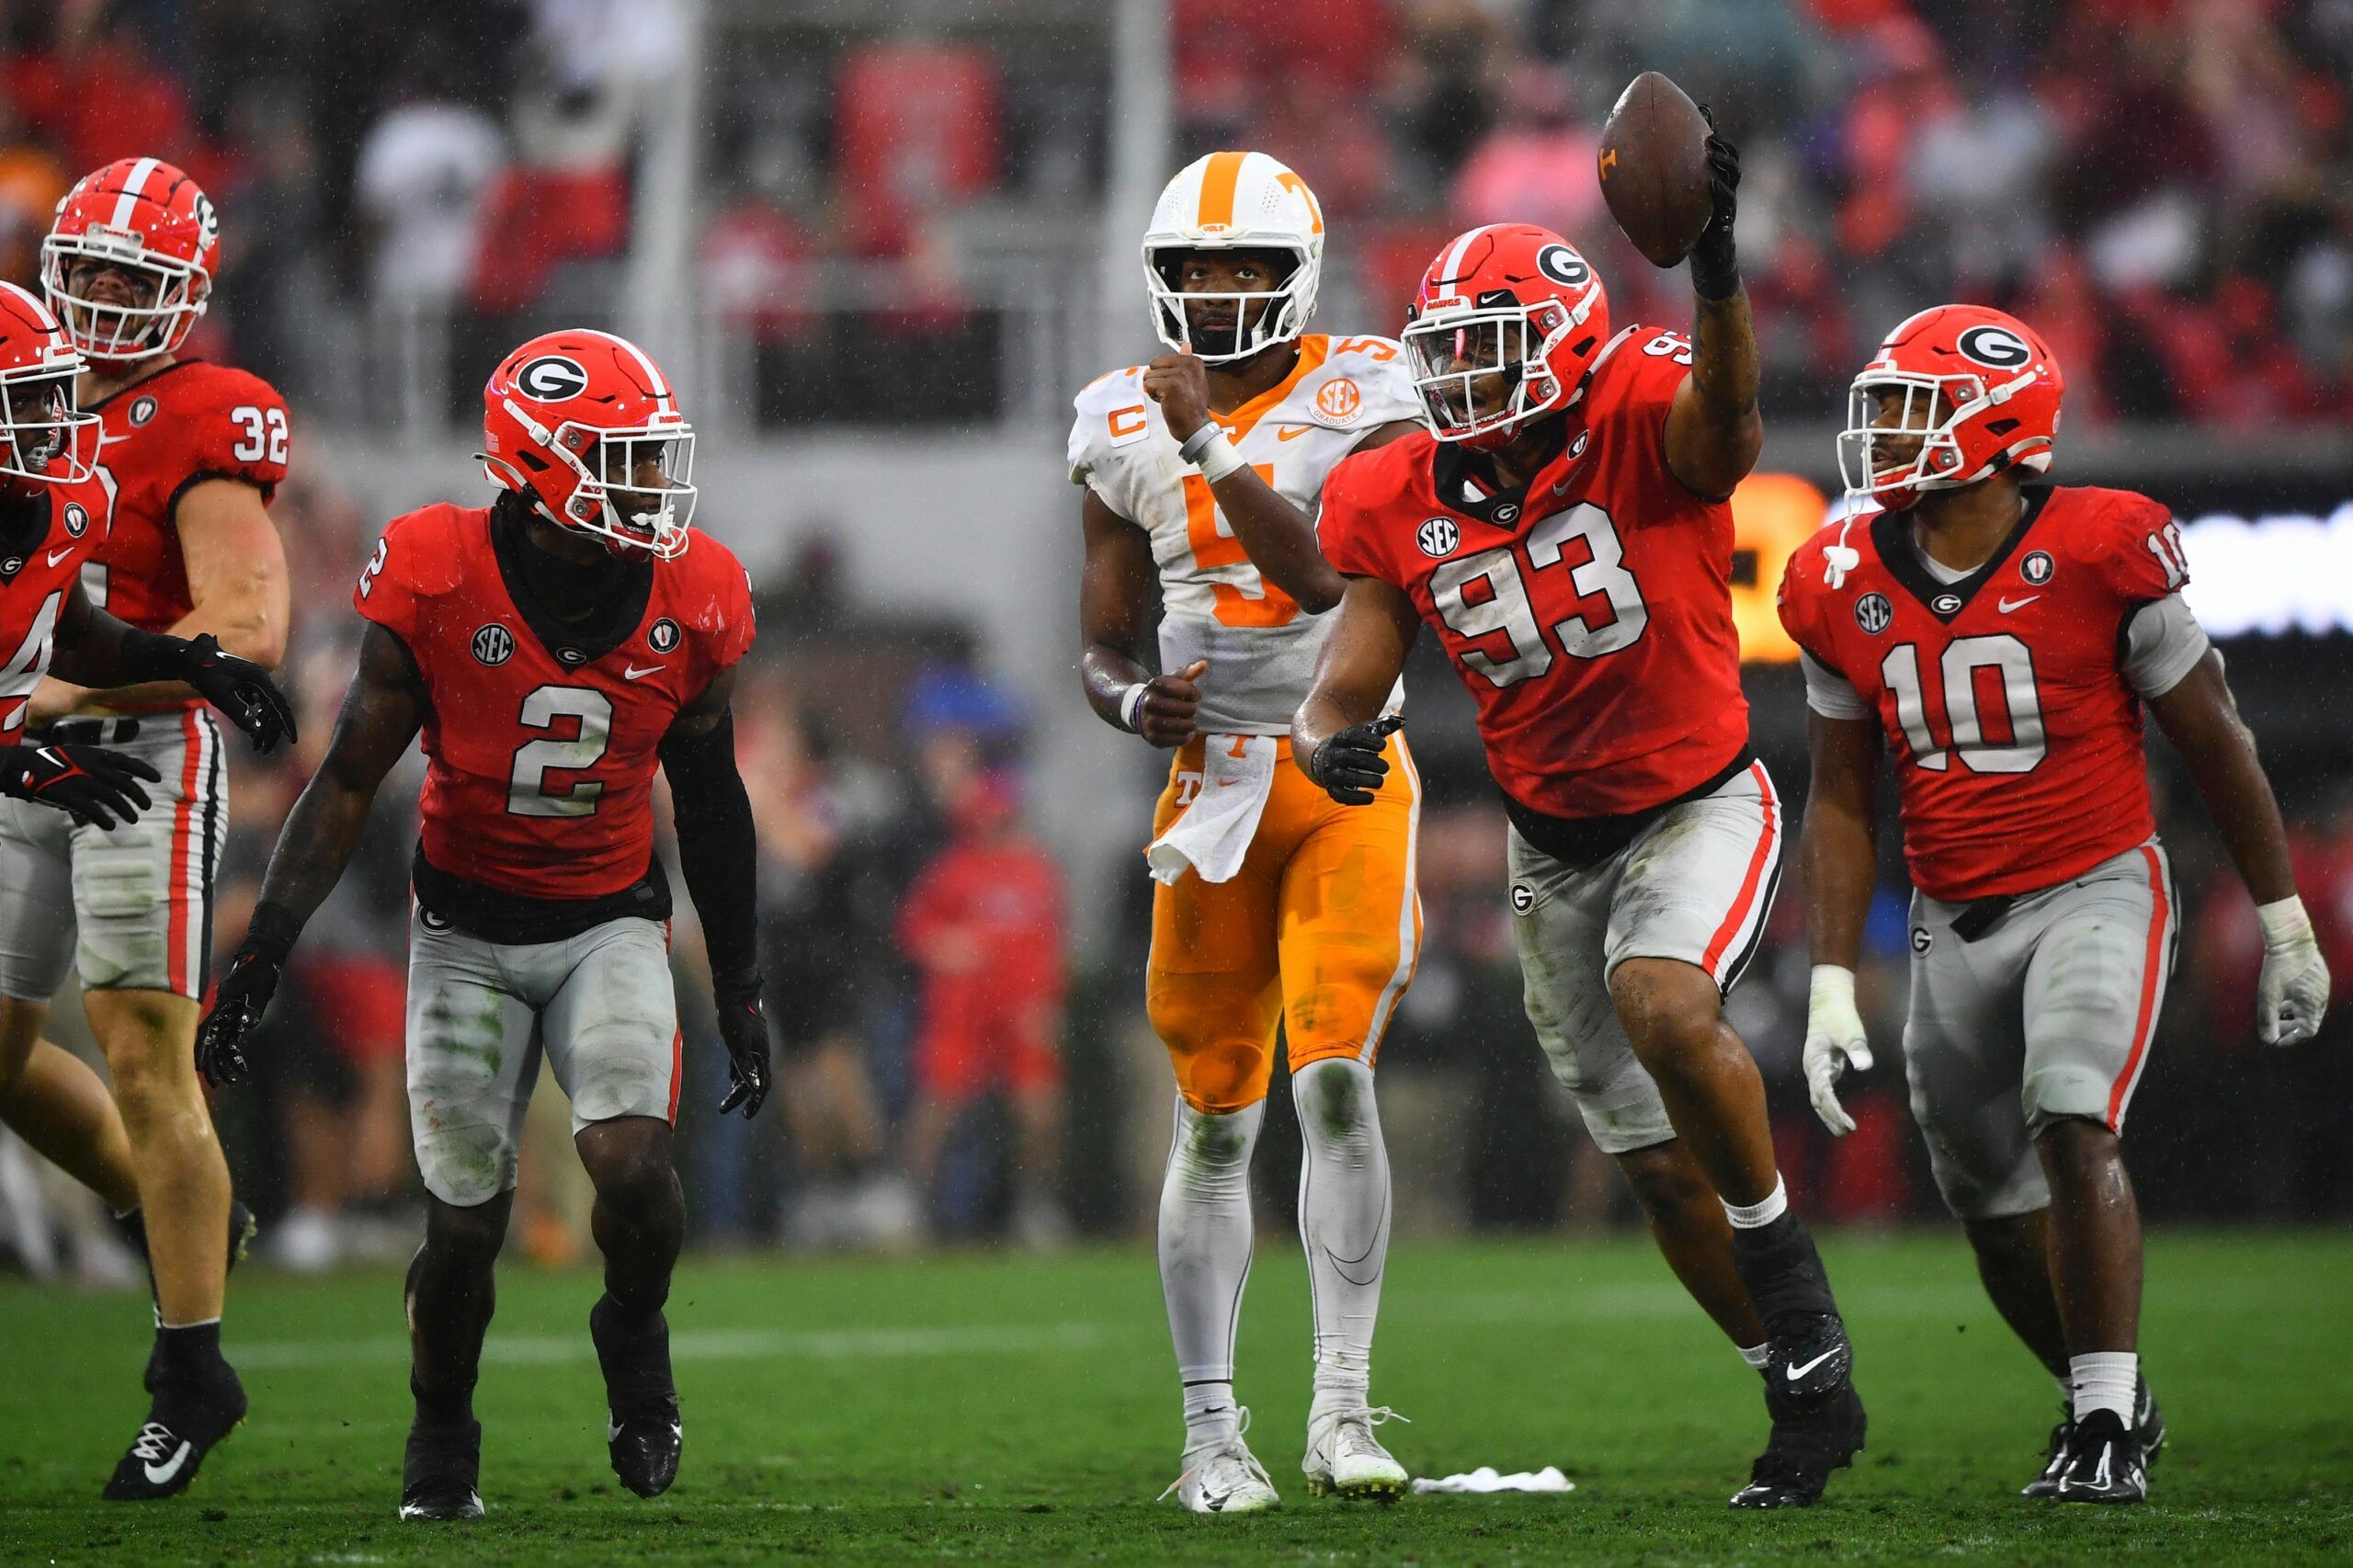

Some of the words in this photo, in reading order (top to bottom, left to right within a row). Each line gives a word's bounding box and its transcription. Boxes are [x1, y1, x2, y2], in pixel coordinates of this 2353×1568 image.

[1549, 248, 1591, 278] G
[1426, 298, 1461, 311] DAWGS
[1977, 333, 2031, 360] G
[526, 360, 590, 395] G
[1321, 381, 1357, 415] SEC
[231, 405, 289, 465] 32
[1108, 404, 1146, 438] C
[1313, 410, 1358, 425] GRADUATE
[1421, 524, 1457, 554] SEC
[357, 537, 389, 601] 2
[1428, 501, 1650, 687] 93
[1858, 595, 1890, 631] SEC
[474, 626, 512, 663] SEC
[1880, 632, 2048, 773] 10
[506, 685, 616, 817] 2
[1175, 769, 1204, 808] T
